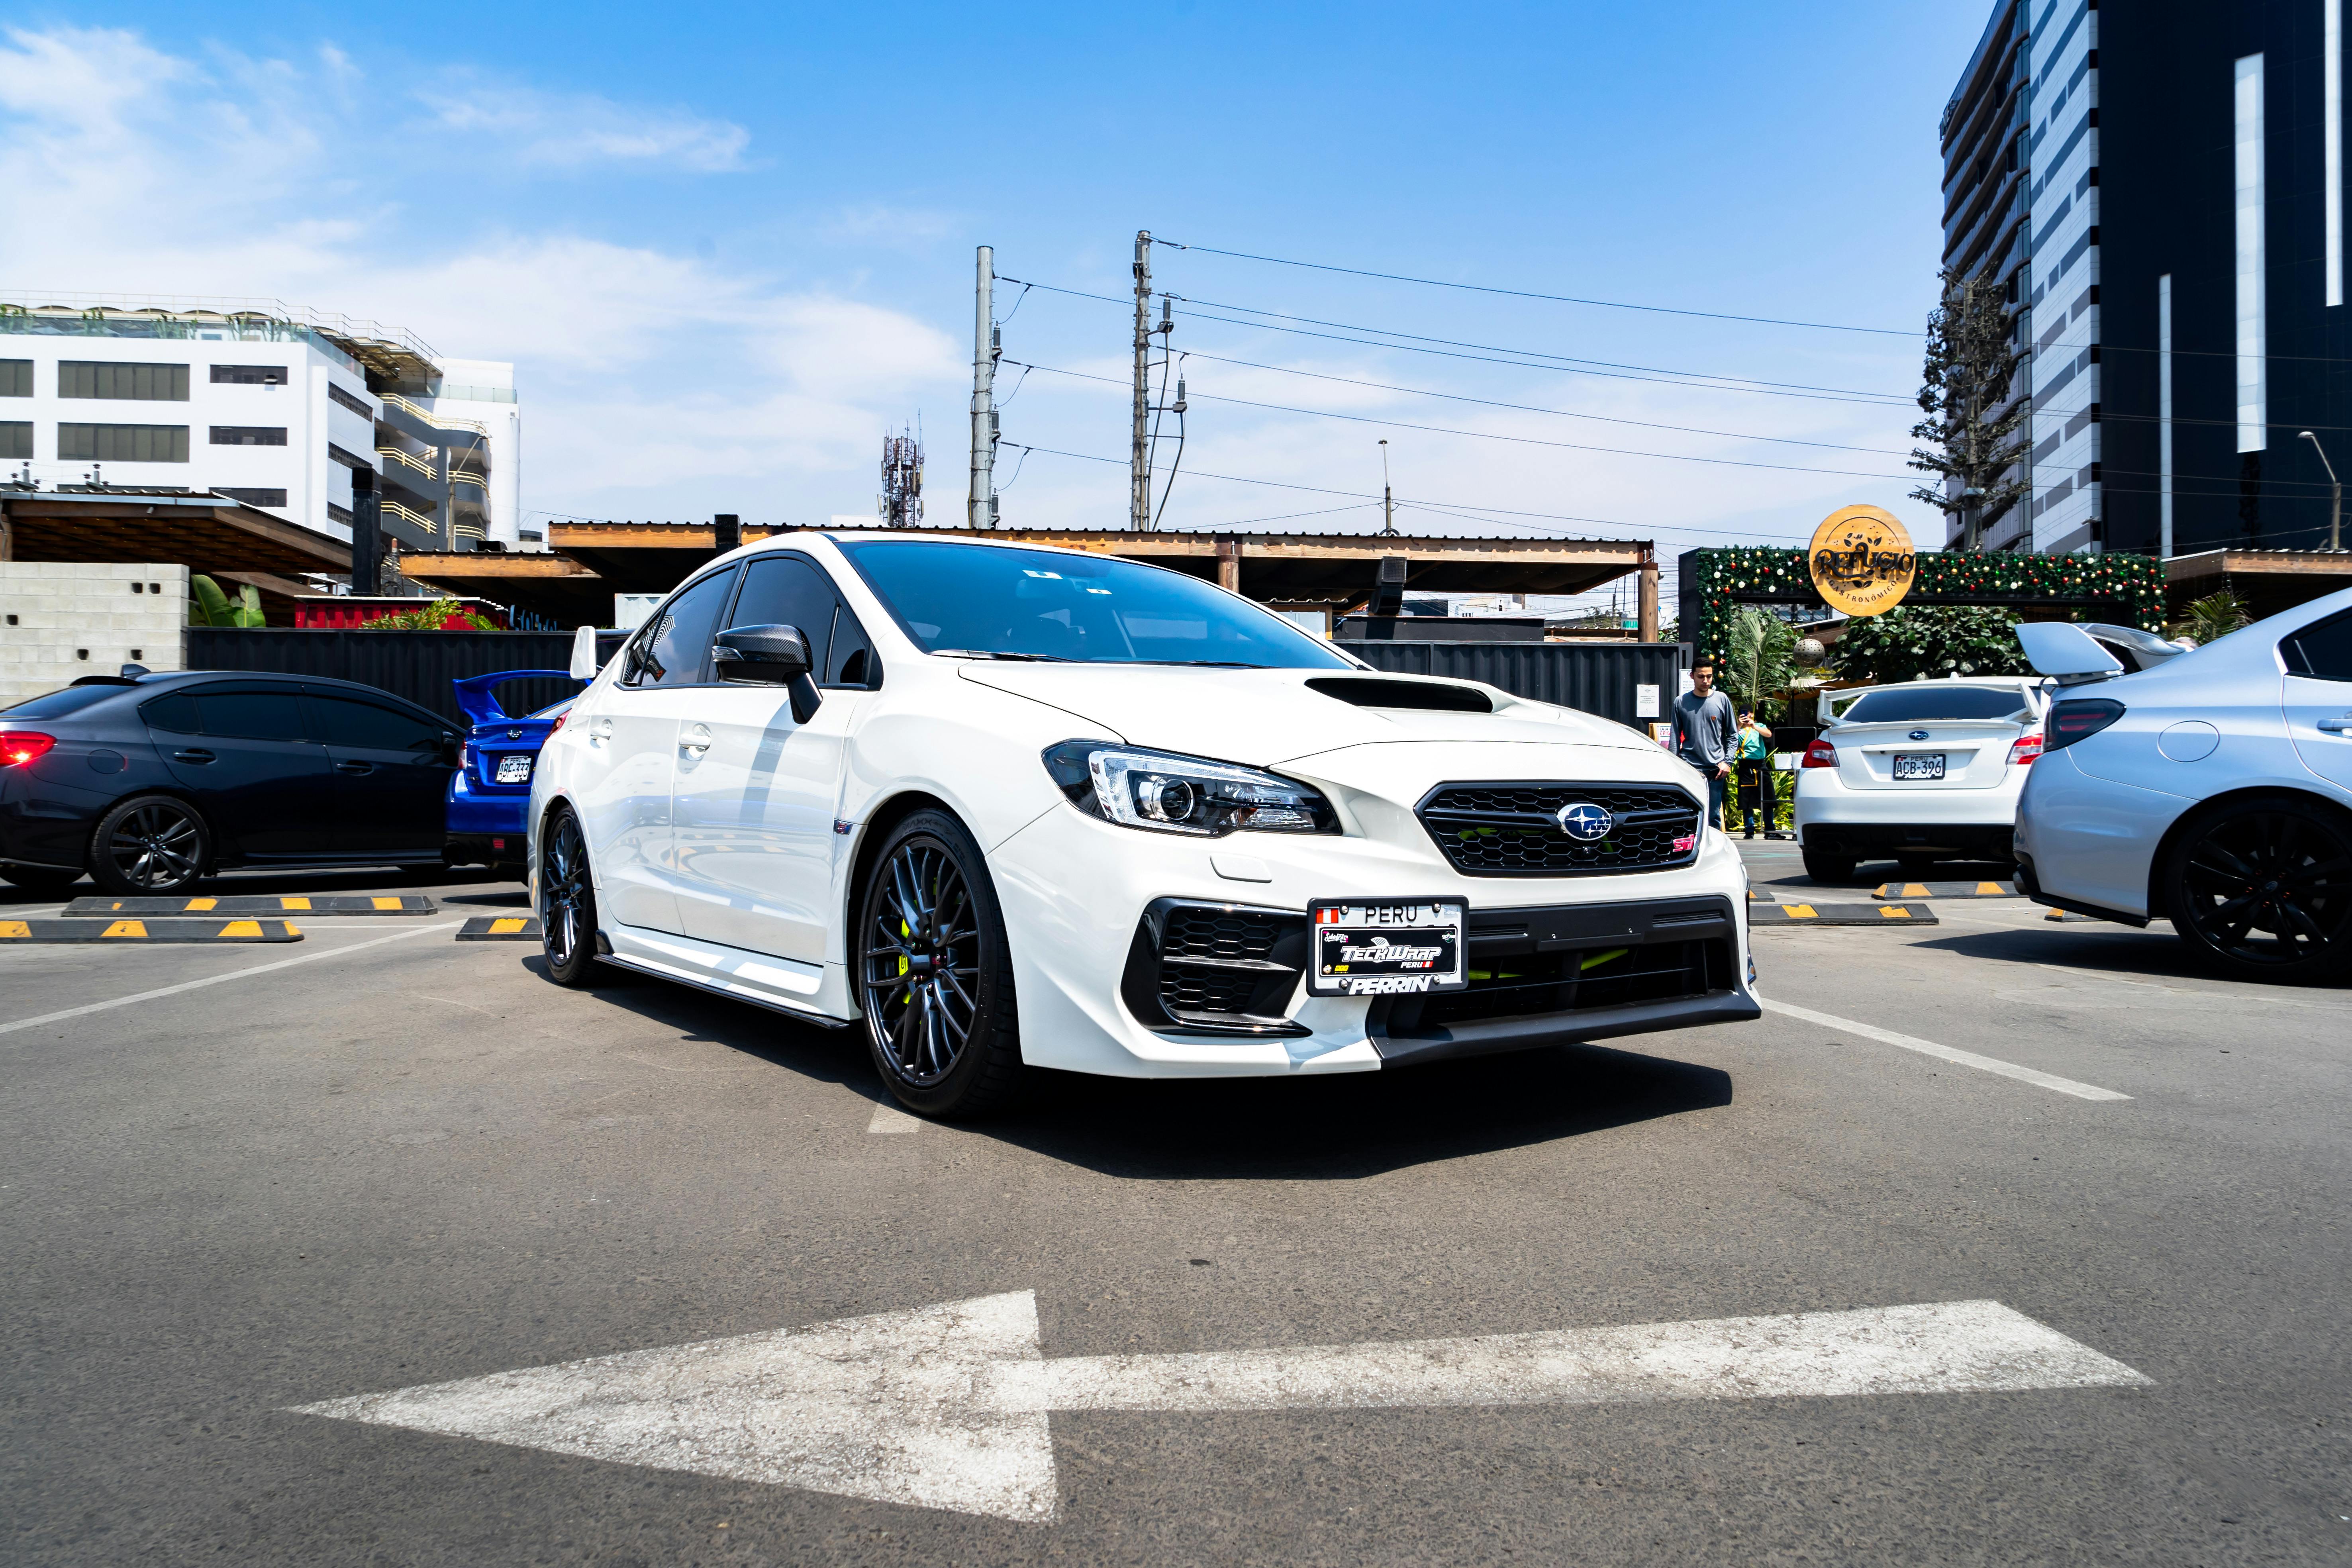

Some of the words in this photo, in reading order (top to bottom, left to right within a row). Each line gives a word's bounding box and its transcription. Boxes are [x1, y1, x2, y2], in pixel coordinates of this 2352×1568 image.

[498, 763, 530, 778] ABF-333
[1896, 761, 1941, 774] ACB-396
[1365, 906, 1417, 923] PERU
[1348, 974, 1432, 995] PERRIN
